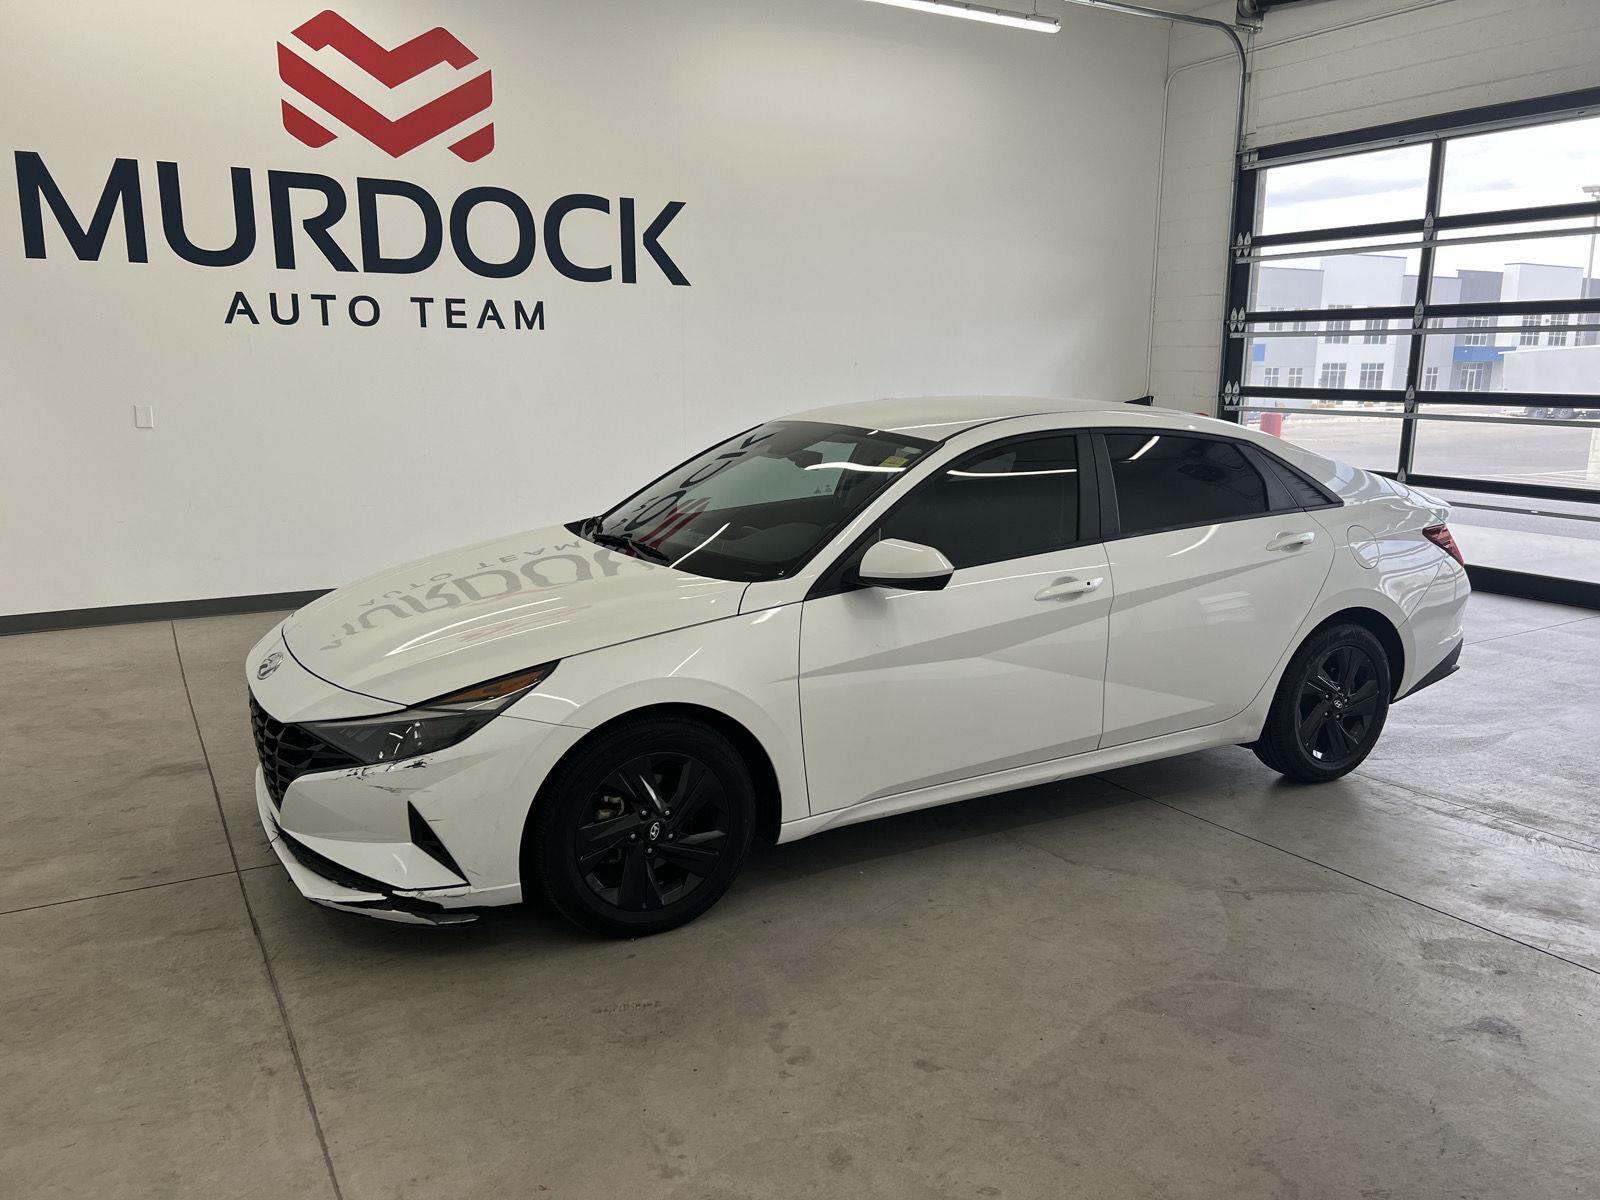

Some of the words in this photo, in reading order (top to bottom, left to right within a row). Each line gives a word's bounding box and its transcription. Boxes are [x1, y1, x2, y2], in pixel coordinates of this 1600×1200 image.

[15, 151, 691, 286] MURDOCK
[225, 292, 380, 326] AUTO
[410, 297, 546, 330] TEAM
